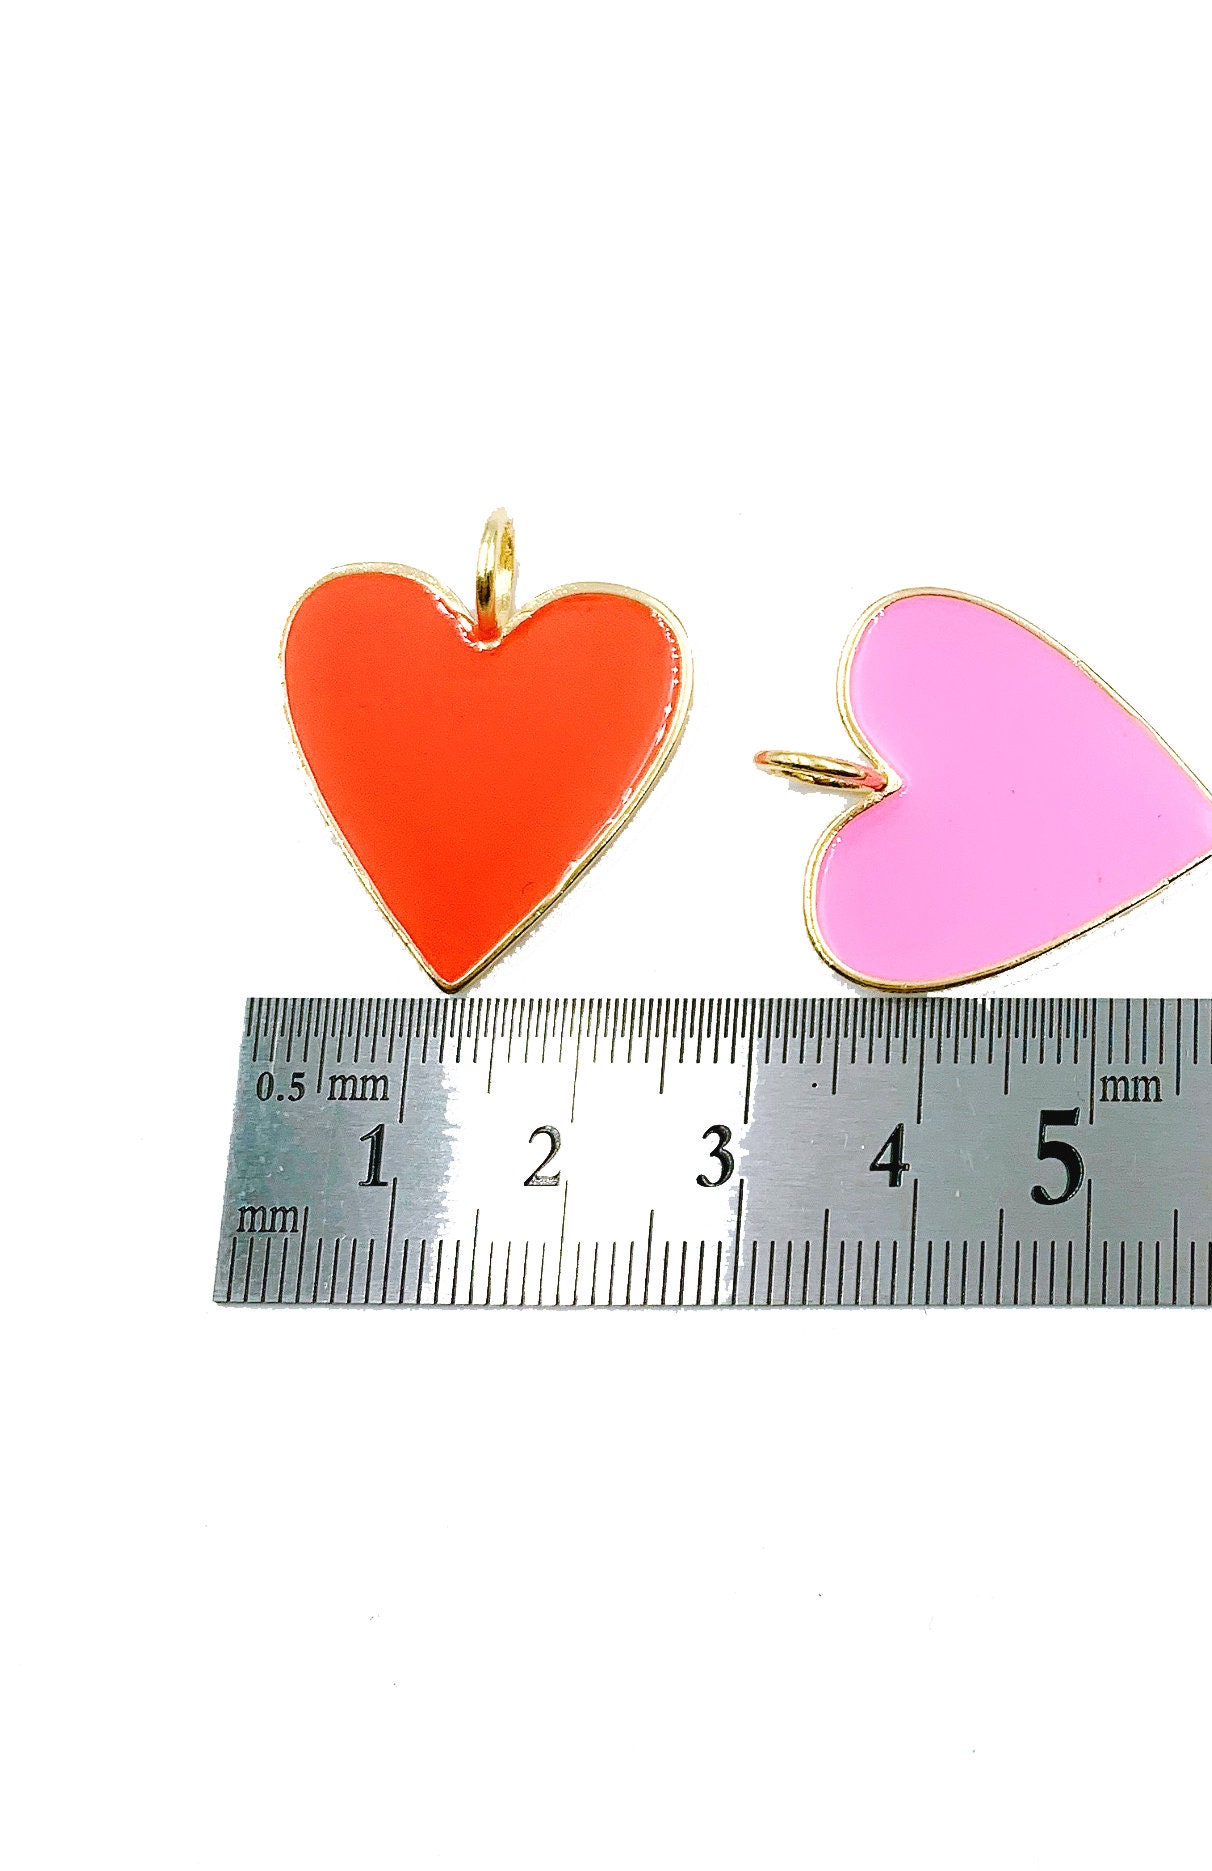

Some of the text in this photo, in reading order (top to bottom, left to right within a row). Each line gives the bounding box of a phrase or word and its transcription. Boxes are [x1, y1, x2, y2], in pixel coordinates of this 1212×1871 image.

[255, 1071, 390, 1102] 0.5 mm
[1099, 1075, 1163, 1103] mm
[359, 1123, 389, 1187] 1
[523, 1125, 562, 1187] 2
[695, 1124, 735, 1188] 3
[869, 1122, 911, 1188] 4
[1030, 1106, 1085, 1206] 5
[235, 1205, 299, 1233] mm
